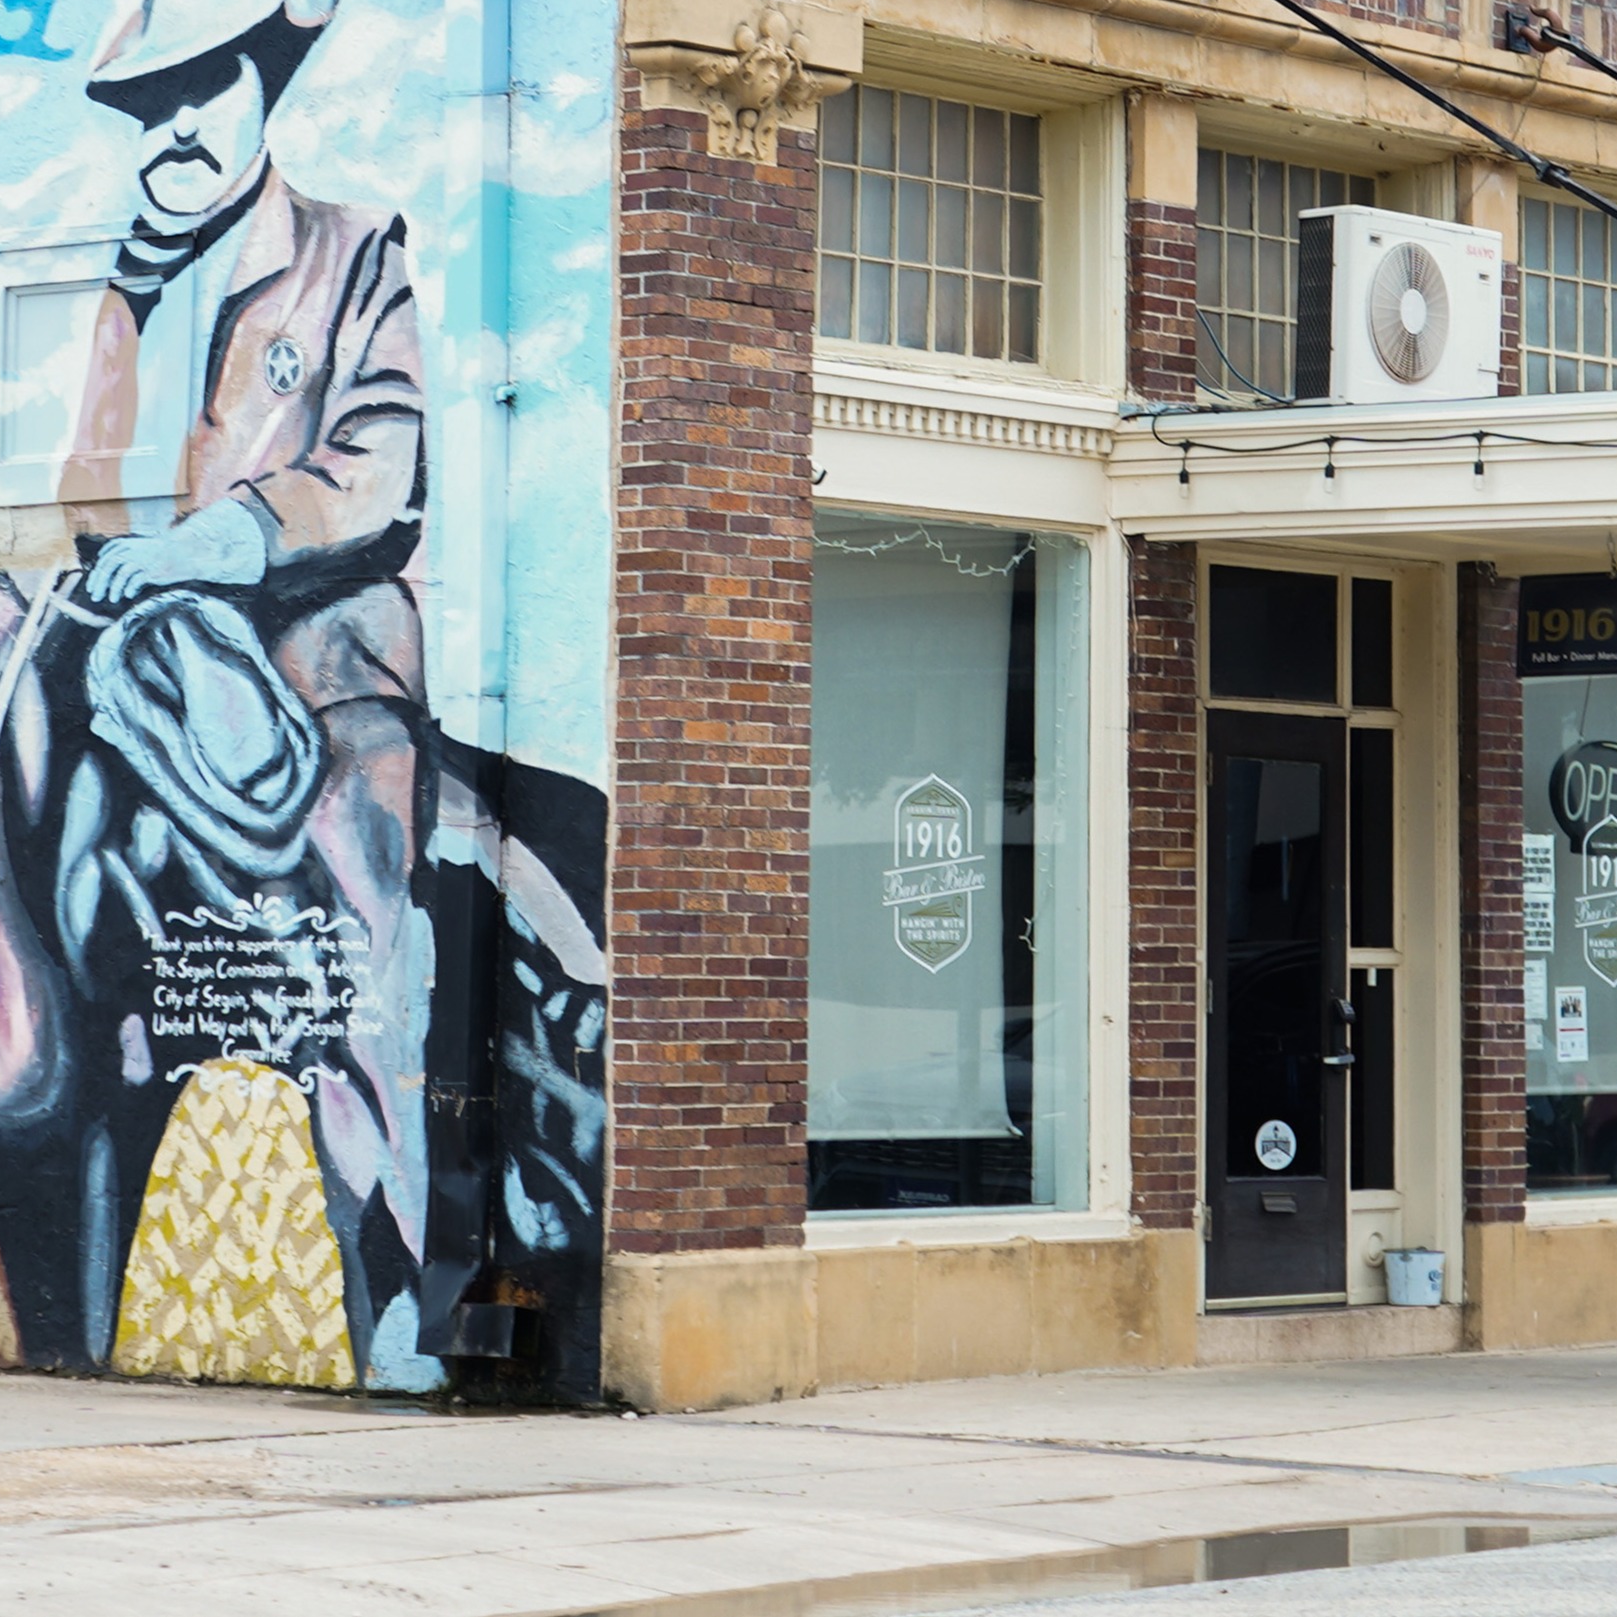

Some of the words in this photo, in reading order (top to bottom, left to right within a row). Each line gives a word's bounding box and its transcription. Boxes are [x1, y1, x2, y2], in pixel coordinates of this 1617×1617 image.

[1526, 607, 1616, 643] 1916
[1570, 651, 1596, 662] Dinner
[906, 821, 963, 859] 1916
[883, 872, 920, 899] Bar
[938, 863, 986, 892] Bistro
[905, 929, 924, 940] THE
[925, 929, 961, 941] SPIRITS
[941, 917, 965, 929] WITH
[213, 935, 234, 952] the
[176, 956, 216, 983] Seguin
[216, 957, 284, 979] Commission
[153, 985, 183, 1011] City
[184, 987, 199, 1007] of
[152, 1013, 195, 1037] United
[197, 1012, 227, 1042] Way
